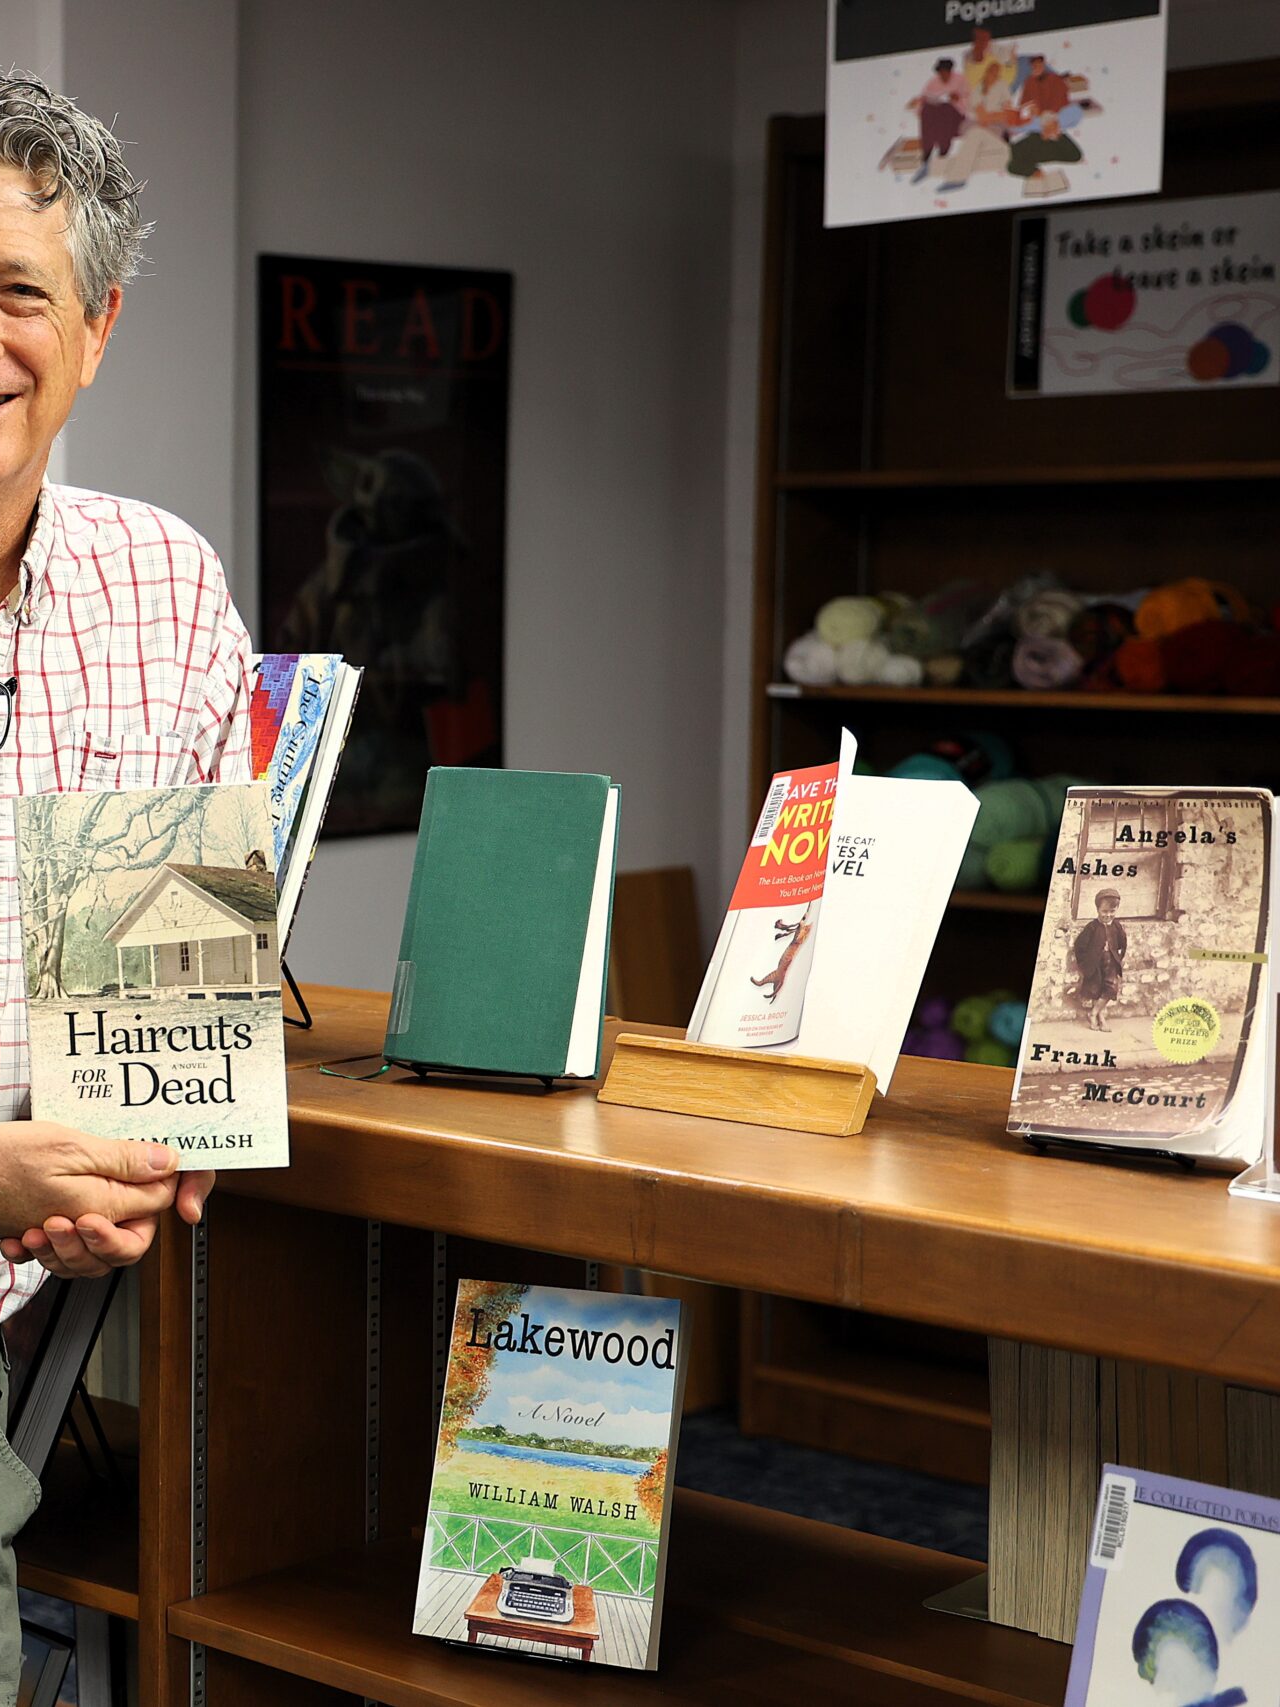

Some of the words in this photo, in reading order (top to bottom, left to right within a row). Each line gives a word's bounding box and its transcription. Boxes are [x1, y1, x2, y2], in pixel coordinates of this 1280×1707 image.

[1056, 228, 1111, 259] Take
[1119, 235, 1134, 253] a
[1211, 226, 1238, 247] or
[279, 274, 503, 361] READ
[300, 673, 322, 714] The
[271, 721, 306, 806] Cutting
[1067, 799, 1084, 807] The
[853, 836, 876, 847] CAT!
[1116, 824, 1237, 848] Angela's
[836, 845, 856, 858] ES
[859, 848, 869, 859] A
[759, 877, 771, 886] The
[772, 875, 786, 885] Last
[788, 873, 804, 883] Book
[805, 873, 813, 882] on
[1057, 857, 1138, 878] Ashes
[780, 887, 798, 897] You'll
[798, 885, 811, 896] Ever
[64, 1010, 253, 1056] Haircuts
[1163, 1027, 1209, 1037] PULITZER
[1170, 1037, 1198, 1046] PRIZE
[1030, 1043, 1117, 1068] Frank
[71, 1068, 106, 1084] FOR
[118, 1054, 236, 1107] Dead
[77, 1084, 113, 1099] THE
[1082, 1083, 1207, 1109] McCourt
[177, 1134, 253, 1150] WALSH
[466, 1308, 675, 1370] Lakewood
[518, 1404, 543, 1420] A
[543, 1405, 606, 1428] Novel
[469, 1482, 559, 1510] WILLIAM
[570, 1496, 638, 1520] WALSH
[1151, 1491, 1231, 1517] COLLECTED
